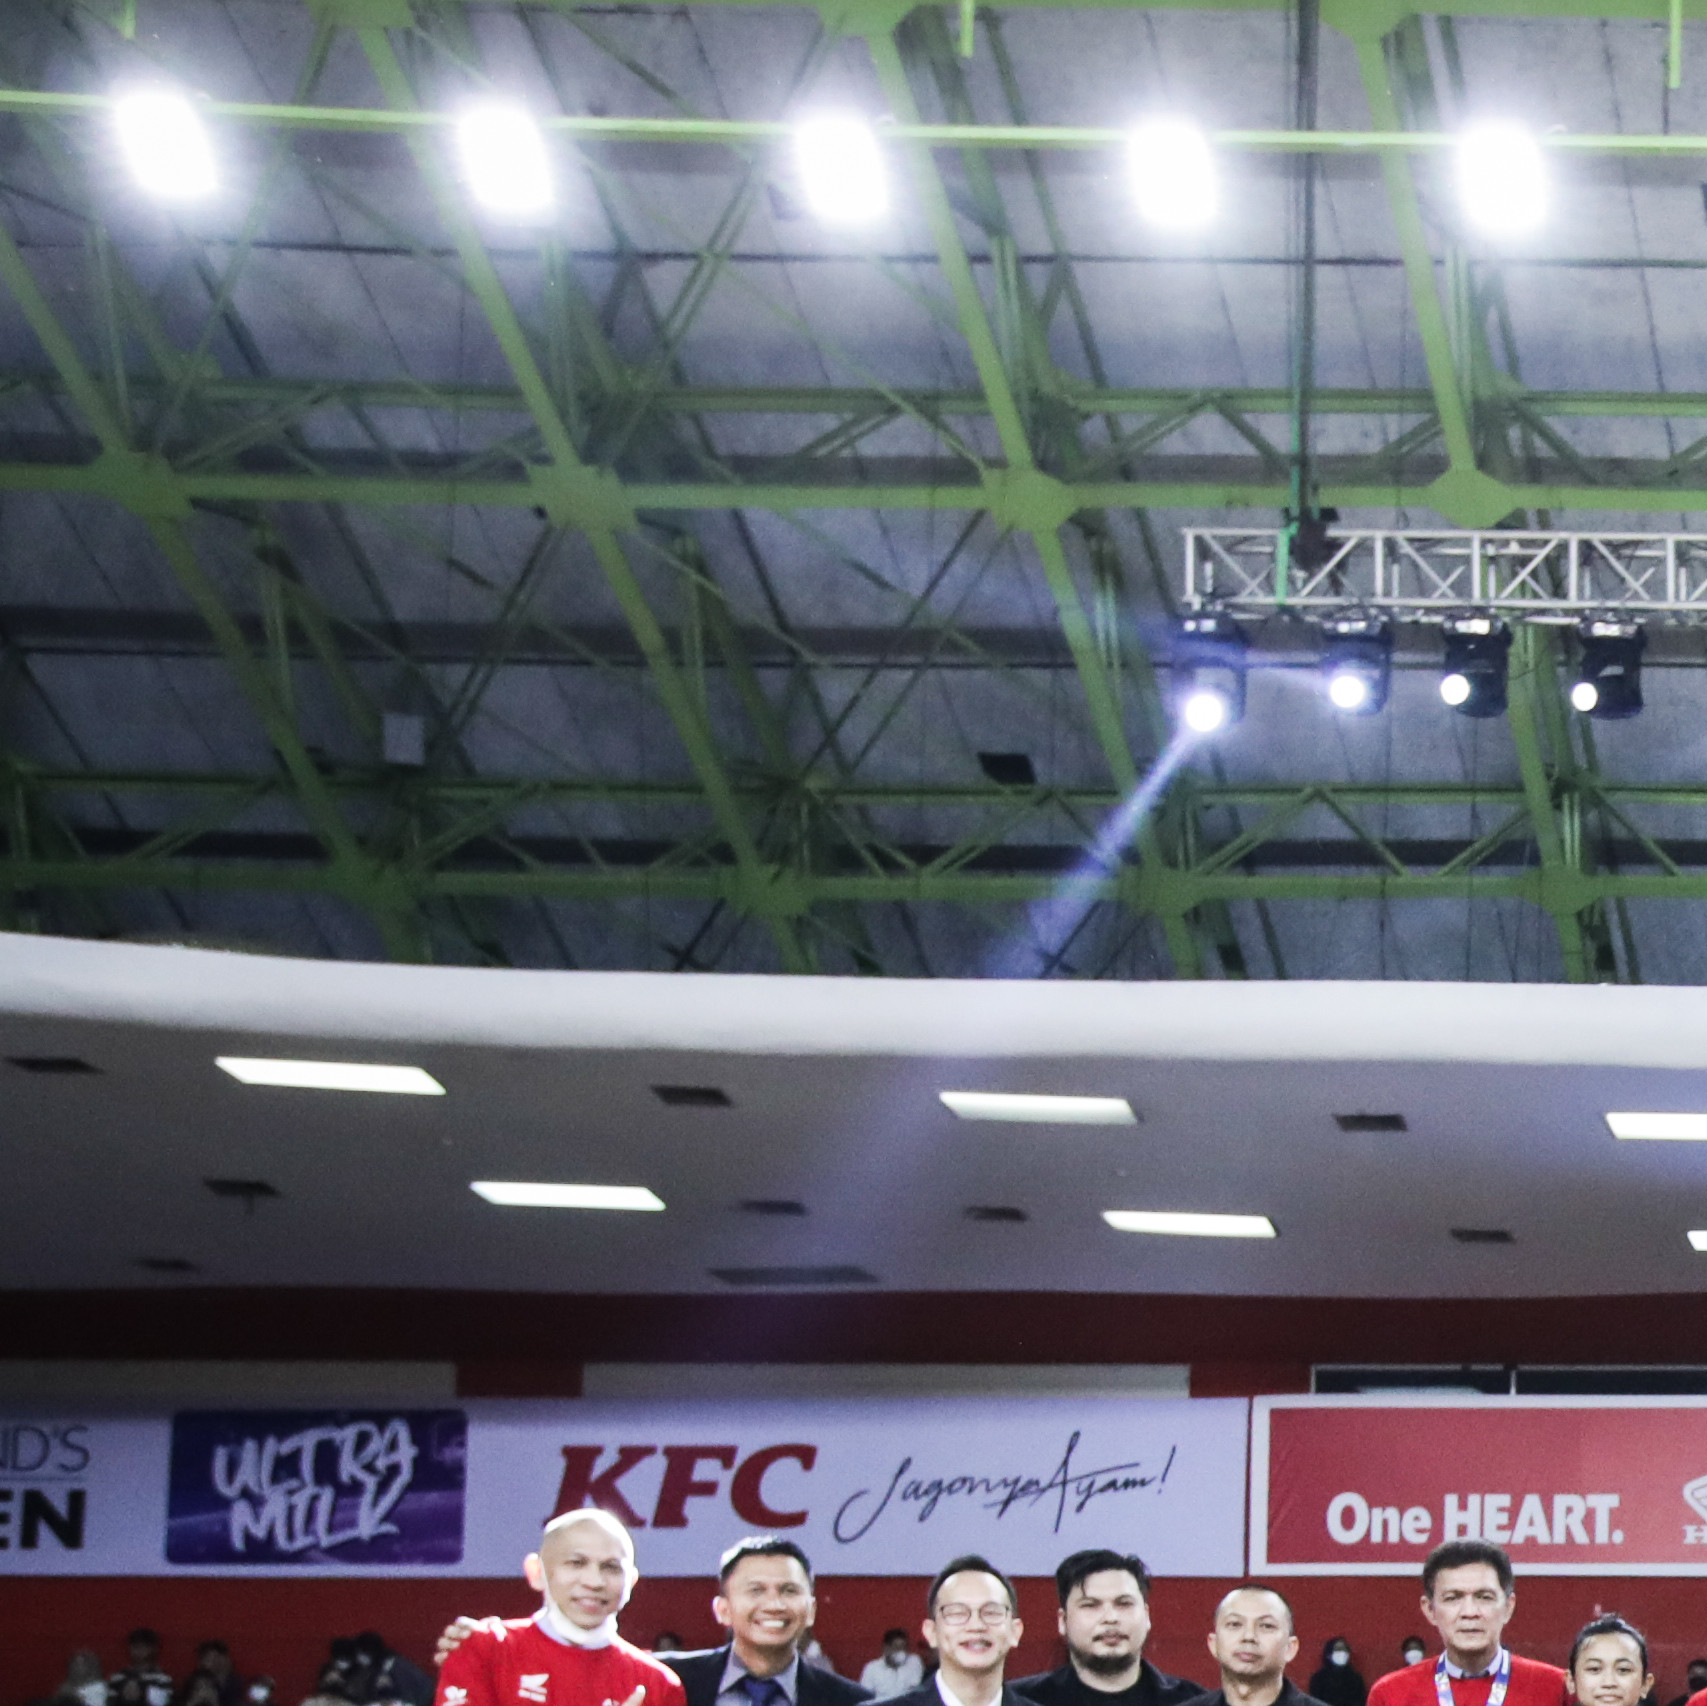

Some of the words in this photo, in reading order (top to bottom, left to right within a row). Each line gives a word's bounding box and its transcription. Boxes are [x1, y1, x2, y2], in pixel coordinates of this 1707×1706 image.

[212, 1418, 418, 1500] ULTRA
[543, 1444, 818, 1529] KFC
[228, 1475, 402, 1552] MILK
[1326, 1491, 1430, 1545] One
[1443, 1493, 1624, 1544] HEART.
